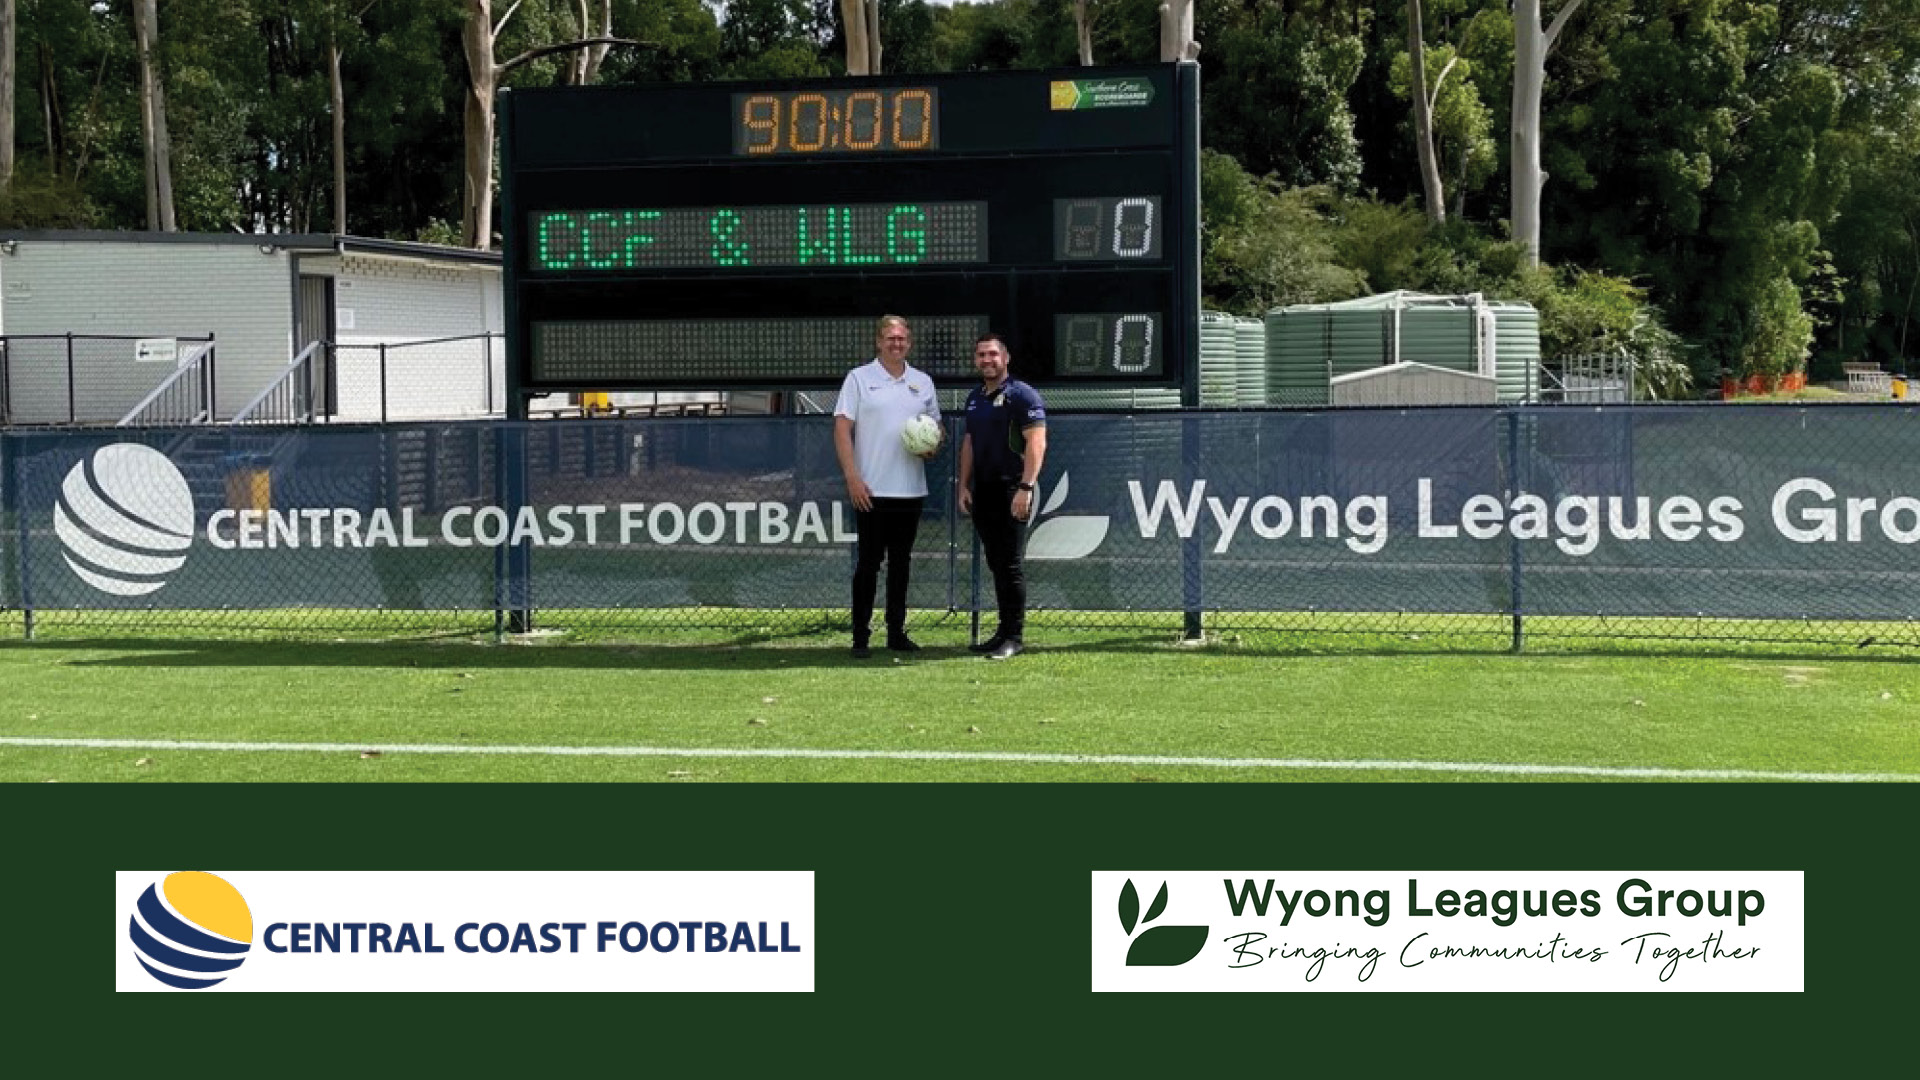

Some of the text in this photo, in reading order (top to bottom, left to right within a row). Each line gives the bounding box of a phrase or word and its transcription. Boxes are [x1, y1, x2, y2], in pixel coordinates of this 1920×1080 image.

[743, 89, 931, 153] 90:00
[537, 204, 927, 269] CCF & WLG
[1112, 198, 1154, 257] 0
[1112, 314, 1154, 373] 0
[206, 501, 859, 550] CENTRAL COAST FOOTBAL
[1127, 479, 1389, 554] Wyong
[1417, 477, 1745, 556] Leagues
